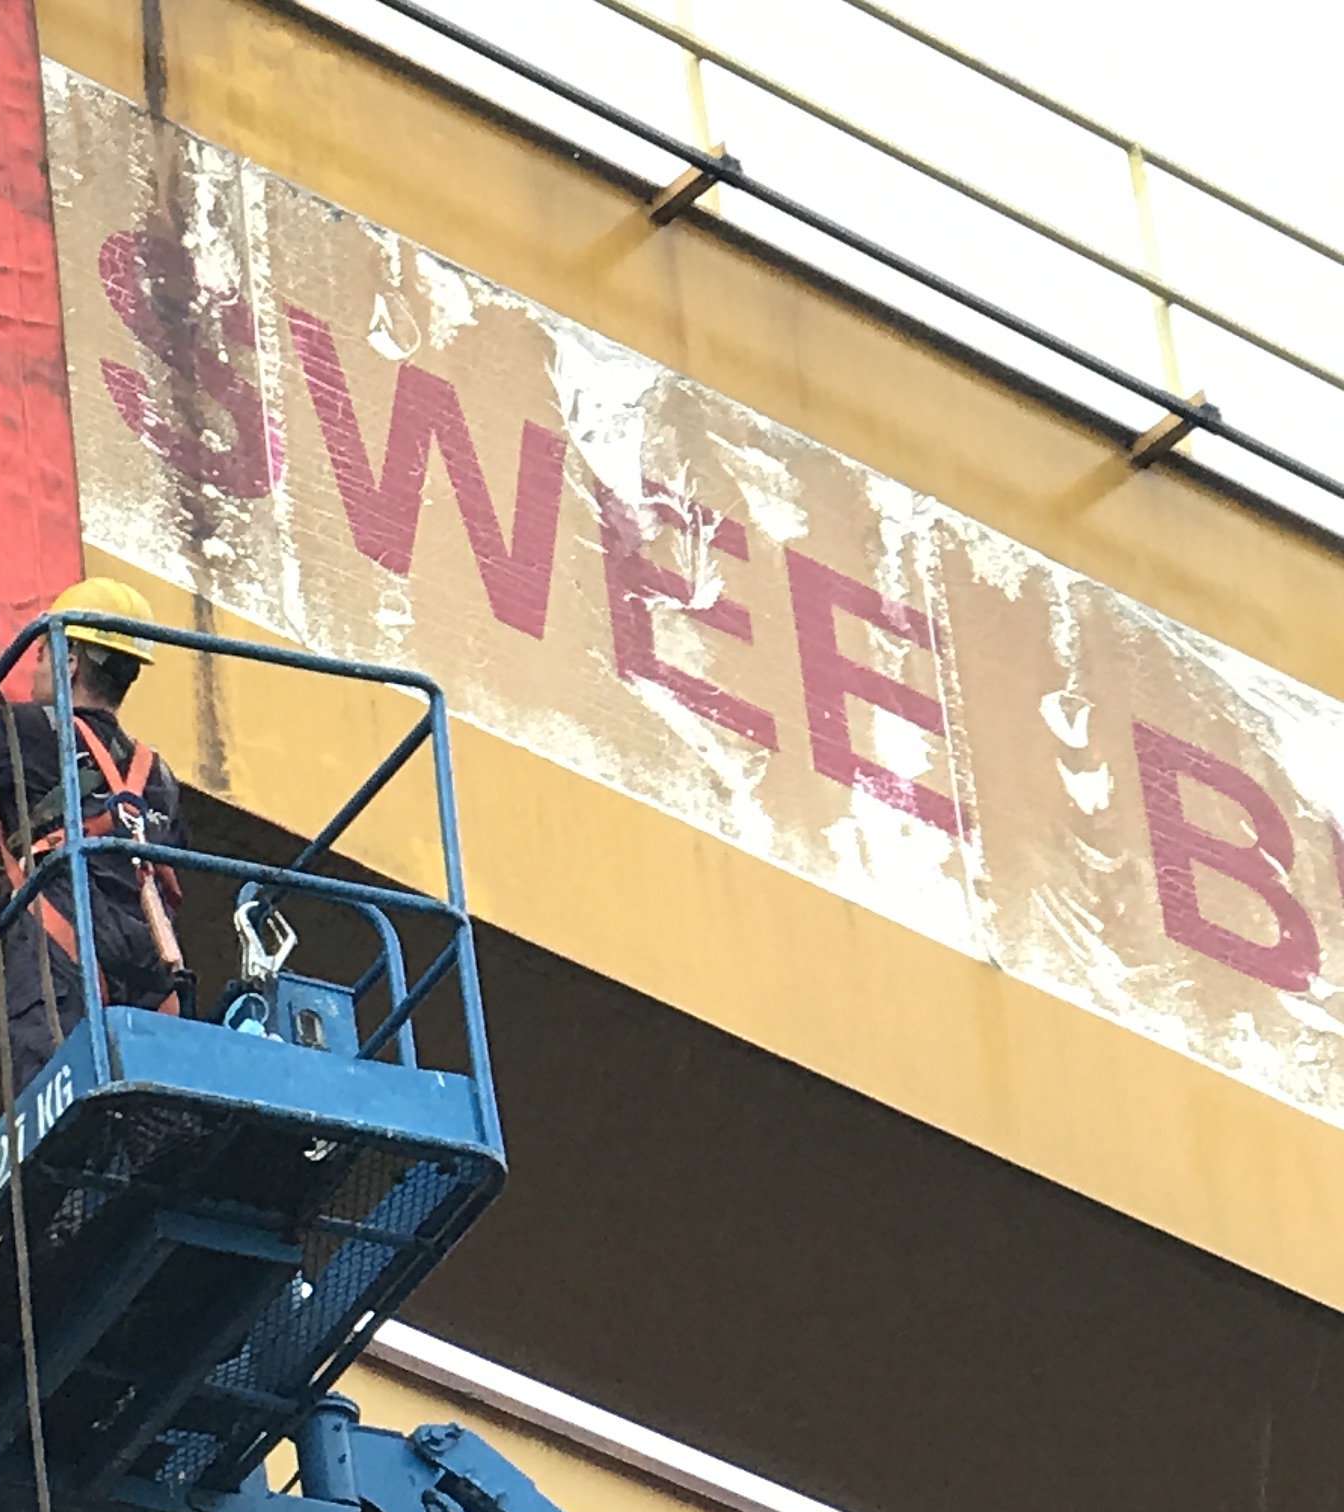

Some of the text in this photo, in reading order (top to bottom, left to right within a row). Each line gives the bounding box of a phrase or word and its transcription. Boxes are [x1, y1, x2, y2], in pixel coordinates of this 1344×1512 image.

[97, 226, 1344, 993] SWEE B
[35, 1064, 75, 1139] KG
